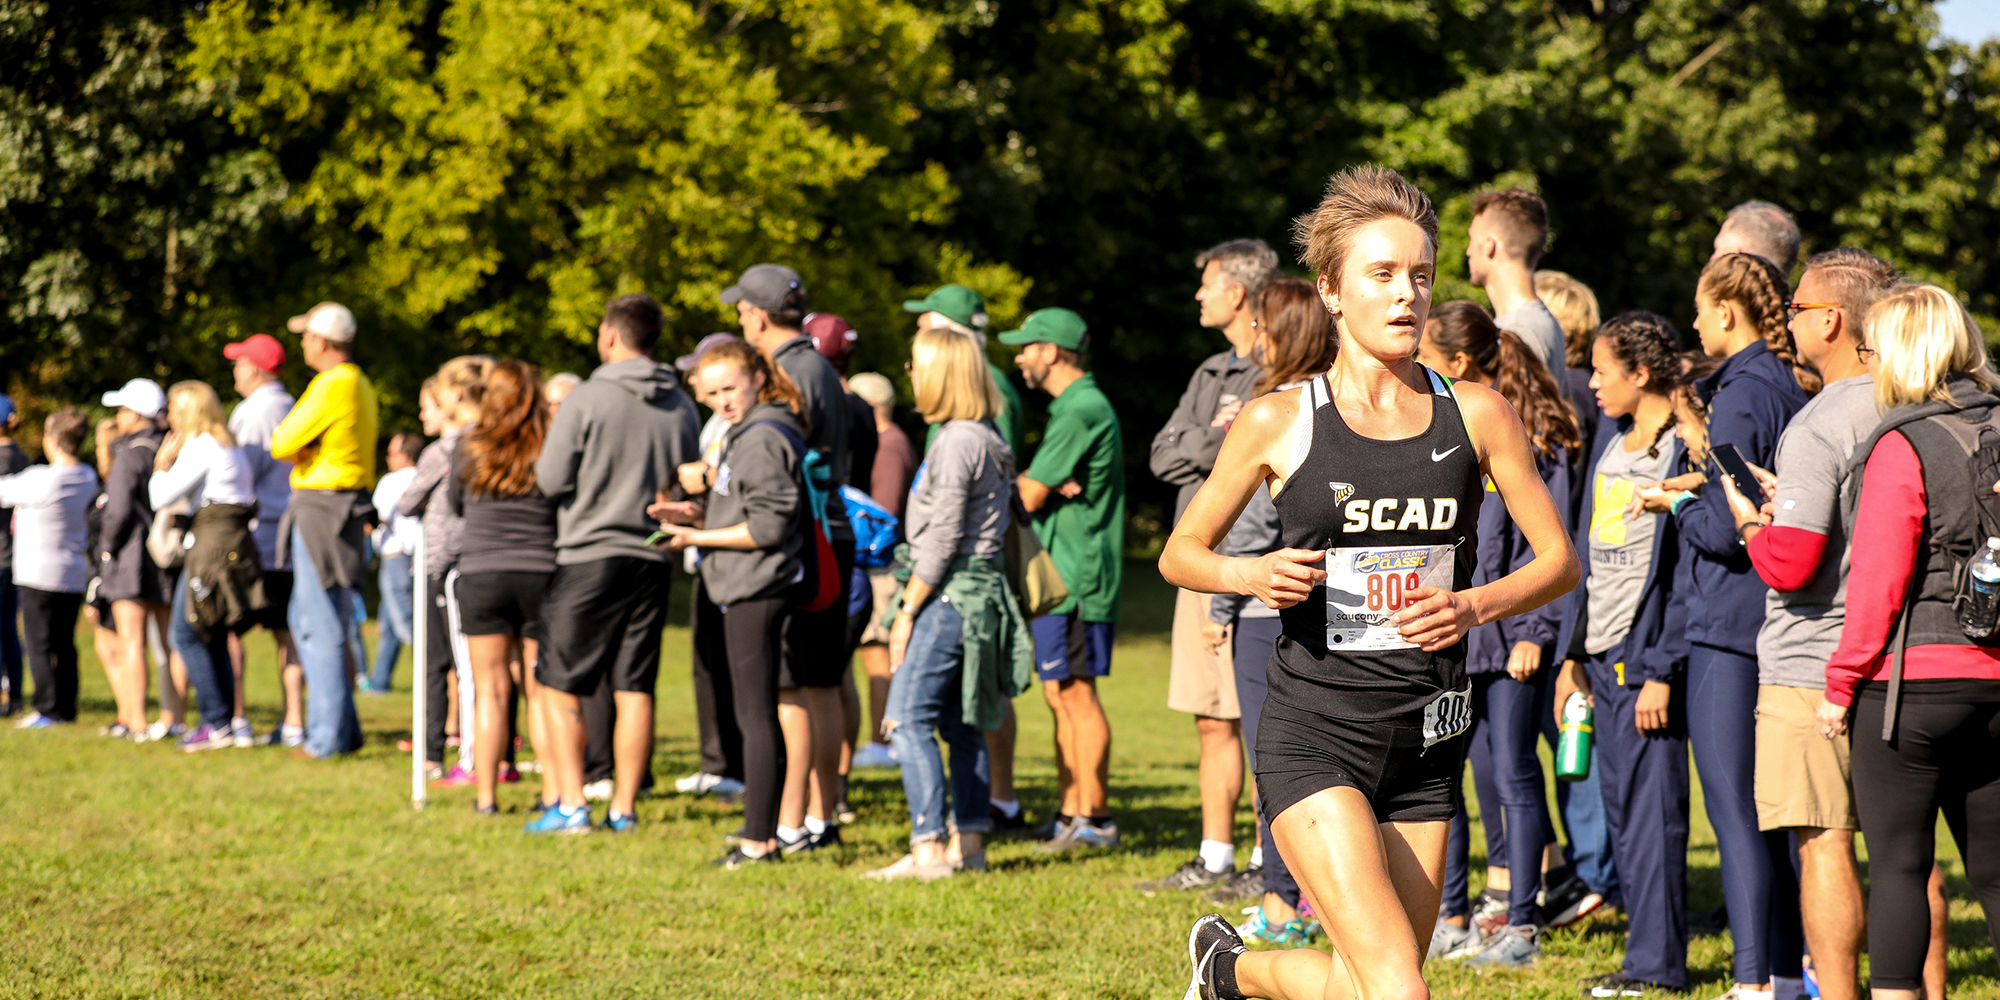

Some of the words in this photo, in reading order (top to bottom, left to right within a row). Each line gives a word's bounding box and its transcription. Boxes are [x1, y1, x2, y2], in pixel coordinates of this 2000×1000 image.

[1343, 497, 1458, 533] SCAD
[1380, 551, 1399, 559] CROSS
[1401, 549, 1429, 558] COUNTRY
[1379, 555, 1427, 569] CLASSIC
[1336, 612, 1378, 621] saucony
